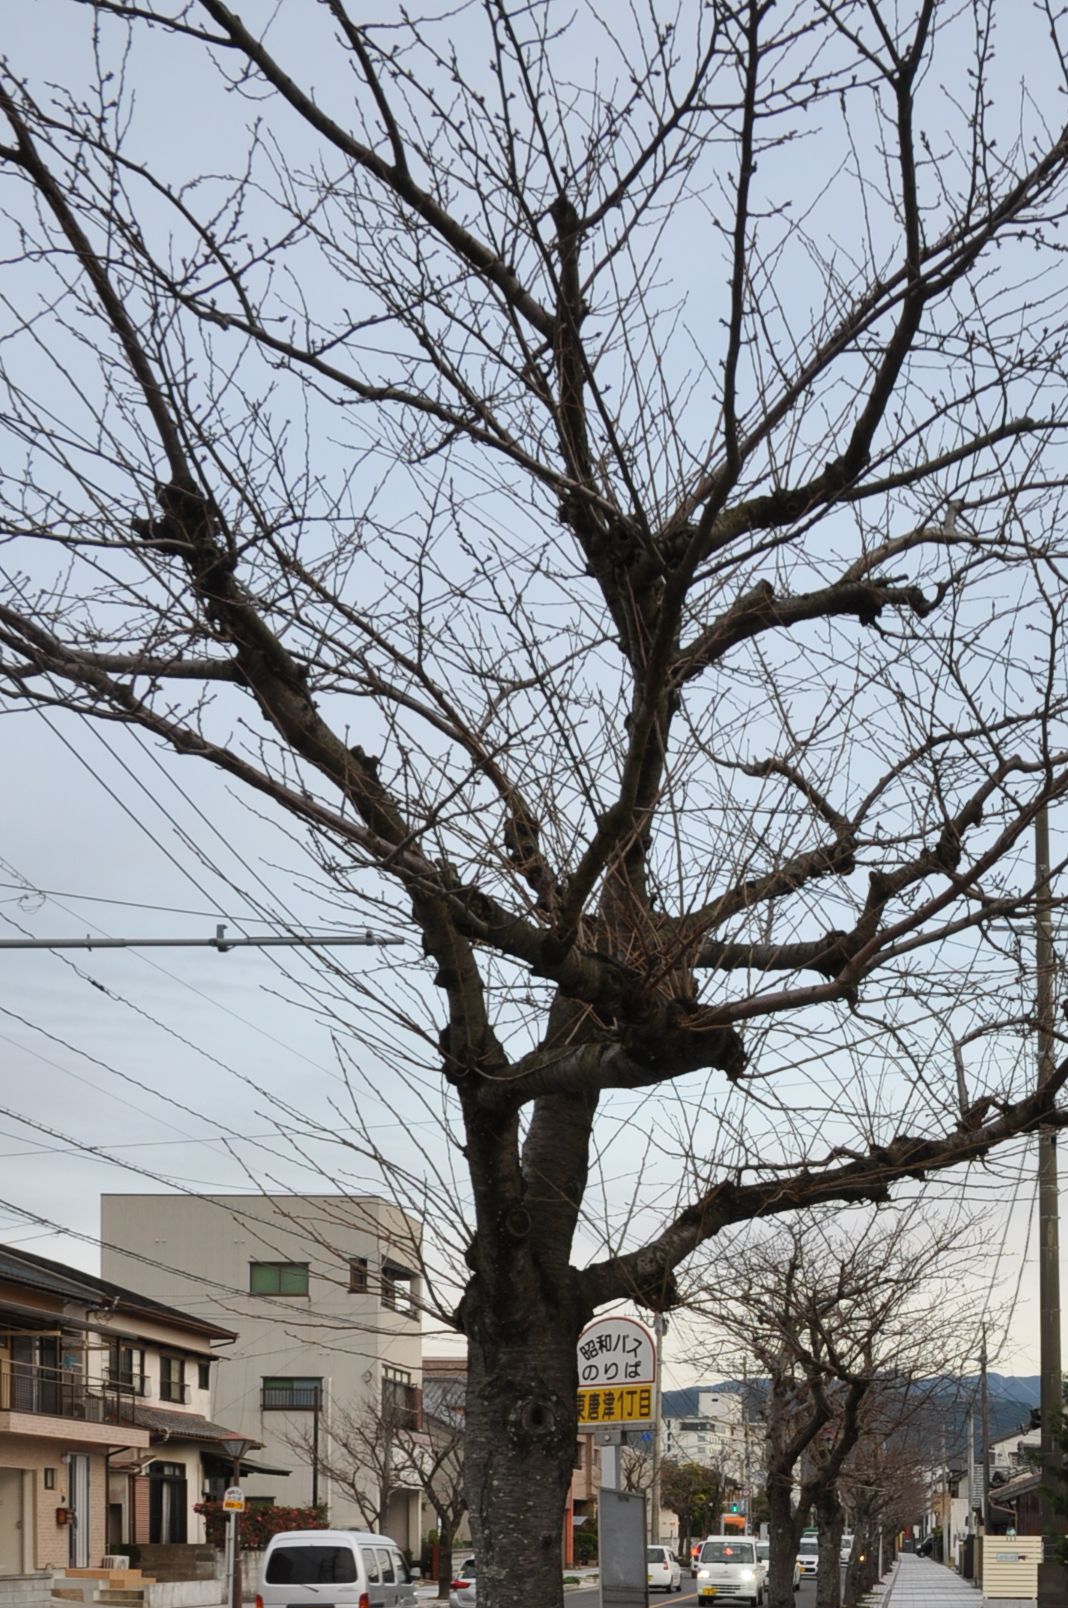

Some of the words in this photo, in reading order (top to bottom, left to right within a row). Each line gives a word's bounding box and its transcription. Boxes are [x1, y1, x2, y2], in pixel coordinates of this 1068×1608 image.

[580, 1334, 642, 1361] 昭和バス
[583, 1360, 642, 1381] のりば
